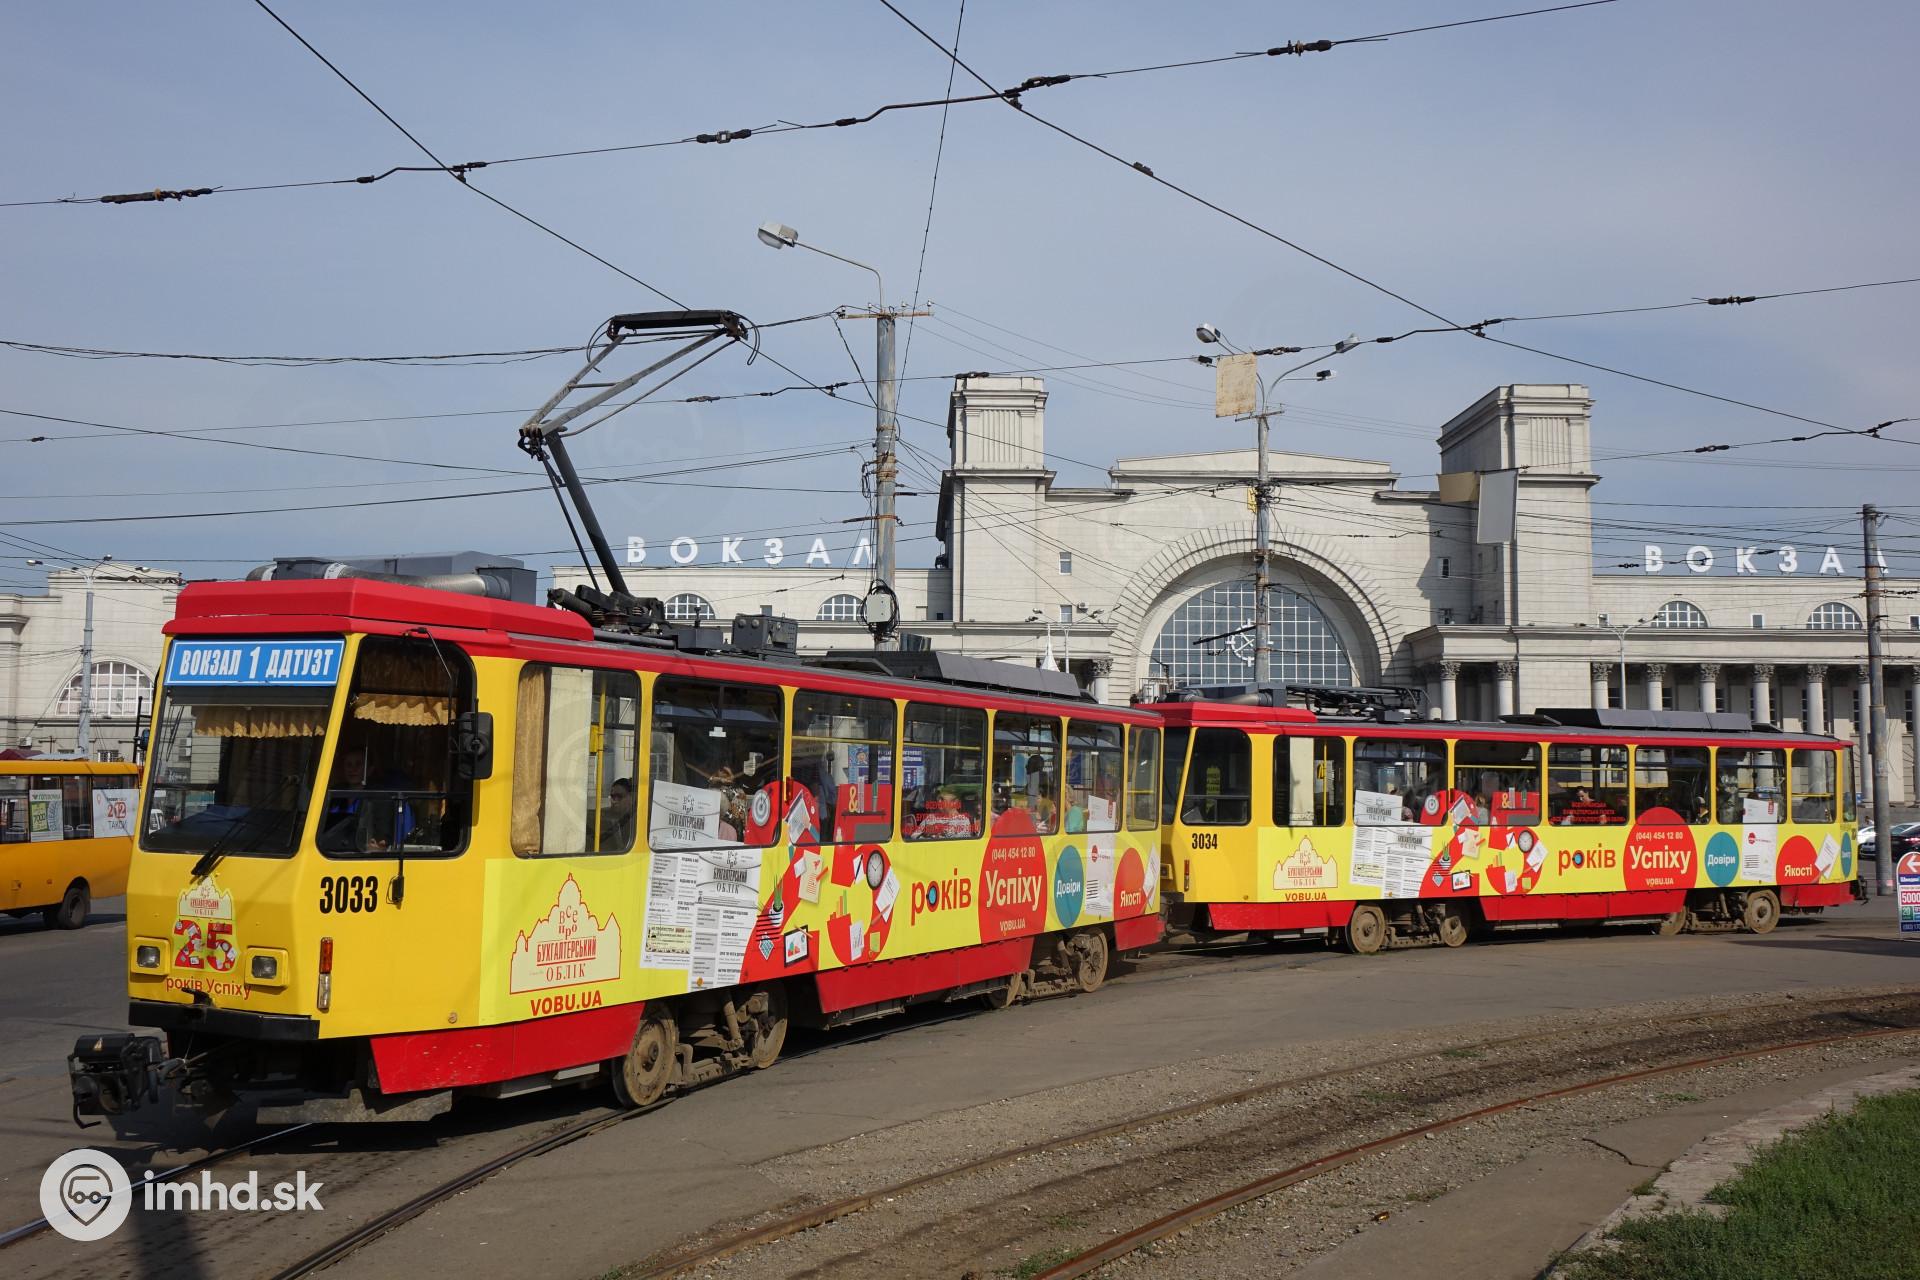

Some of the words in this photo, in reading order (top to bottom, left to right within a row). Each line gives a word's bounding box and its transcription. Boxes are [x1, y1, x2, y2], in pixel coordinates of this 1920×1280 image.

[627, 536, 876, 565] ВОКЗАЛ
[179, 649, 242, 676] ВОКЗАЛ
[249, 646, 261, 679] 1
[265, 648, 334, 678] ДДТУЗТ
[1192, 833, 1218, 849] 3034
[991, 848, 1006, 864] (044)
[1008, 848, 1019, 859] 454
[1021, 847, 1028, 858] 12
[1559, 843, 1616, 876] років
[1630, 845, 1691, 874] Успіху
[1708, 853, 1736, 867] Довіри
[1784, 864, 1812, 877] Якості
[320, 875, 378, 914] 3033
[911, 868, 972, 926] років
[985, 868, 1042, 912] Успіху
[1056, 879, 1081, 899] Довіри
[1120, 888, 1141, 907] Якості
[1285, 892, 1327, 901] VOBU.UA
[173, 919, 236, 972] 25
[536, 938, 597, 963] БУХГАЛТЕРСЬКИЙ
[546, 963, 586, 982] ОБЛІК
[165, 976, 202, 992] років
[206, 979, 251, 1000] Успіху
[530, 990, 602, 1016] VOBU.UA
